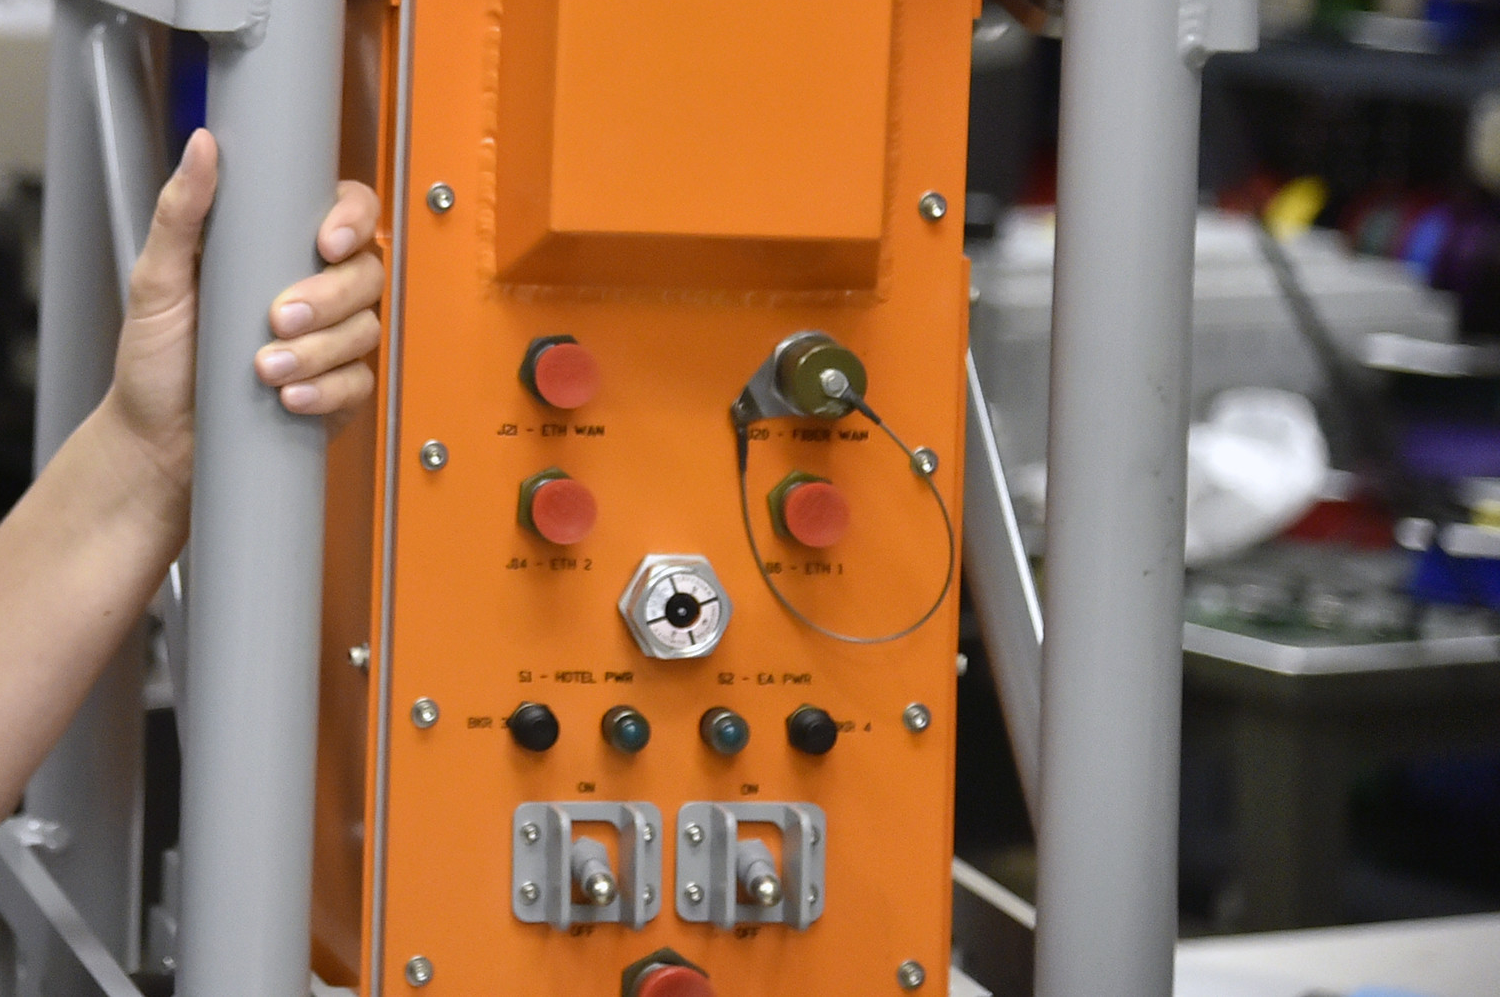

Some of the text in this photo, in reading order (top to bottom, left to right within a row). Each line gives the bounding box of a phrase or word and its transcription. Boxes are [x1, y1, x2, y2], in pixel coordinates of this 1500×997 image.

[542, 424, 567, 437] ETH
[575, 425, 605, 437] WAN
[839, 430, 869, 442] WAN
[550, 558, 577, 571] ETH
[584, 558, 593, 571] 2
[805, 562, 831, 576] ETH
[838, 563, 843, 575] 1
[519, 671, 532, 683] S1
[556, 671, 596, 684] HOTEL
[605, 671, 633, 683] PWR
[758, 672, 774, 685] EA
[783, 673, 812, 685] PWR
[467, 717, 492, 729] BKR
[578, 781, 596, 793] ON
[740, 783, 759, 795] ON
